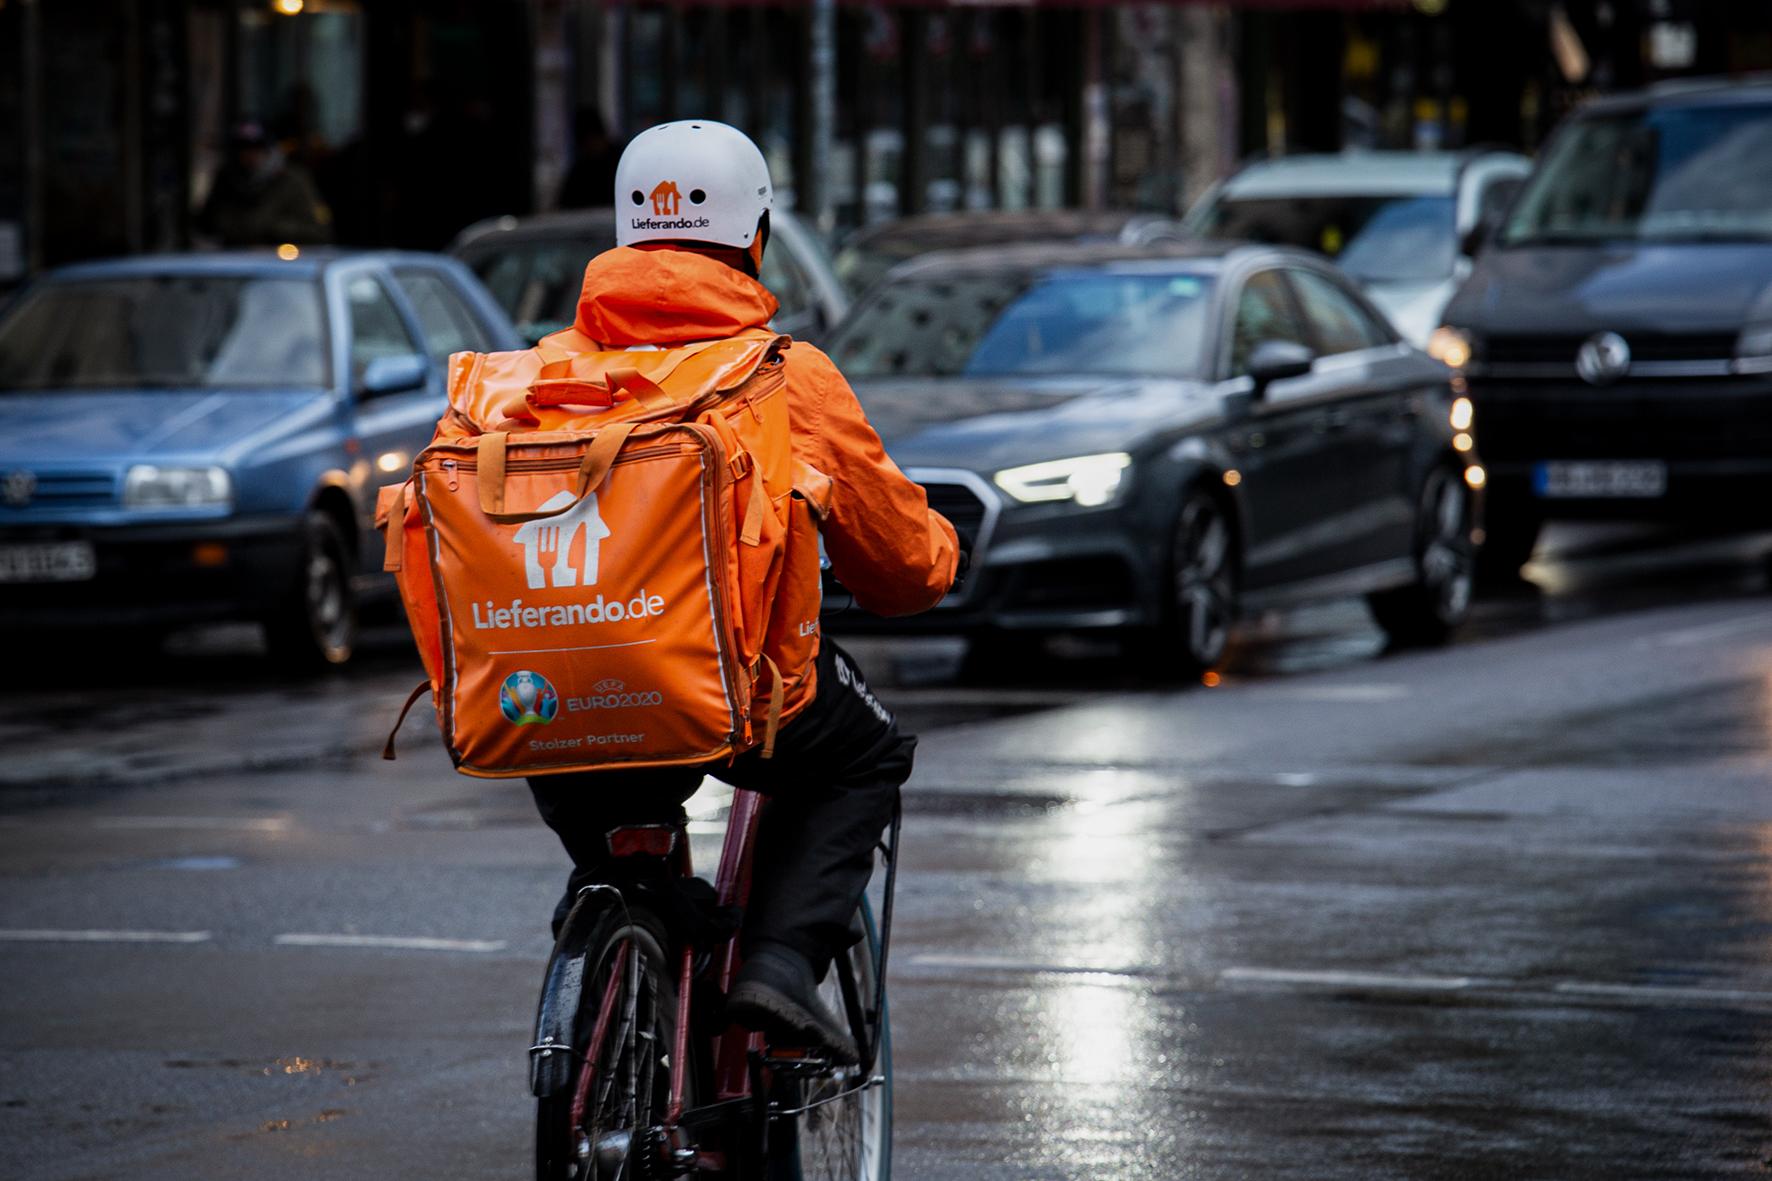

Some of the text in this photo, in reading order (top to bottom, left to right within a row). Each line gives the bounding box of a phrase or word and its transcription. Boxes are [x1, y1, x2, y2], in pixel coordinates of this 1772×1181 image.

[631, 216, 710, 230] Lieferando.de
[471, 588, 665, 629] Lieferando.de
[594, 679, 624, 693] UEFA
[529, 733, 644, 752] Stolzer Partner
